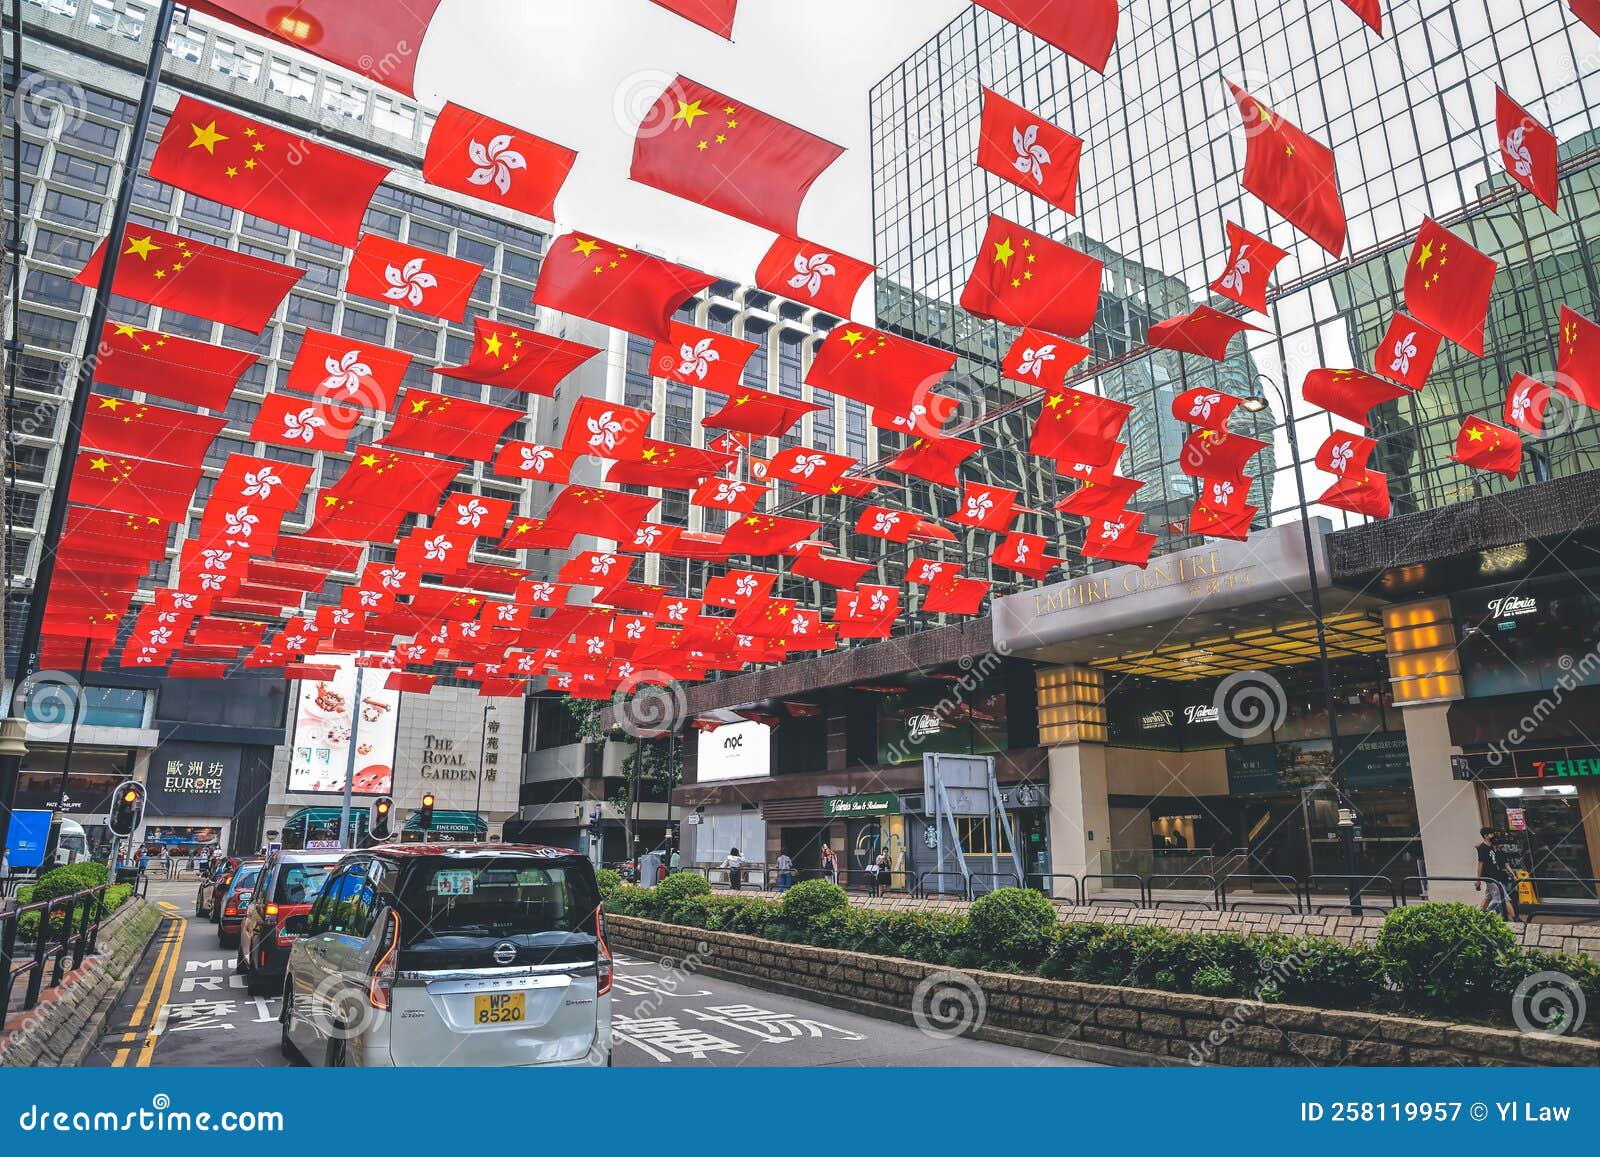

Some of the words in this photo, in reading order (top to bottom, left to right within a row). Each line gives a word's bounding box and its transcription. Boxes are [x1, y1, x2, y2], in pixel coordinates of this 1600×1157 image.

[1034, 579, 1113, 615] EMPIRE
[1122, 550, 1226, 593] CENTRE
[1488, 597, 1536, 619] Valeria
[1184, 704, 1219, 724] Valeria
[908, 714, 940, 736] Valeria
[424, 735, 453, 751] THE
[422, 750, 466, 767] ROYAL
[485, 721, 500, 782] 帝苑酒店
[166, 761, 224, 777] 歐洲坊
[421, 765, 477, 781] GARDEN
[165, 777, 222, 790] EUROPE
[489, 994, 511, 1008] WP
[479, 1007, 521, 1023] 8520
